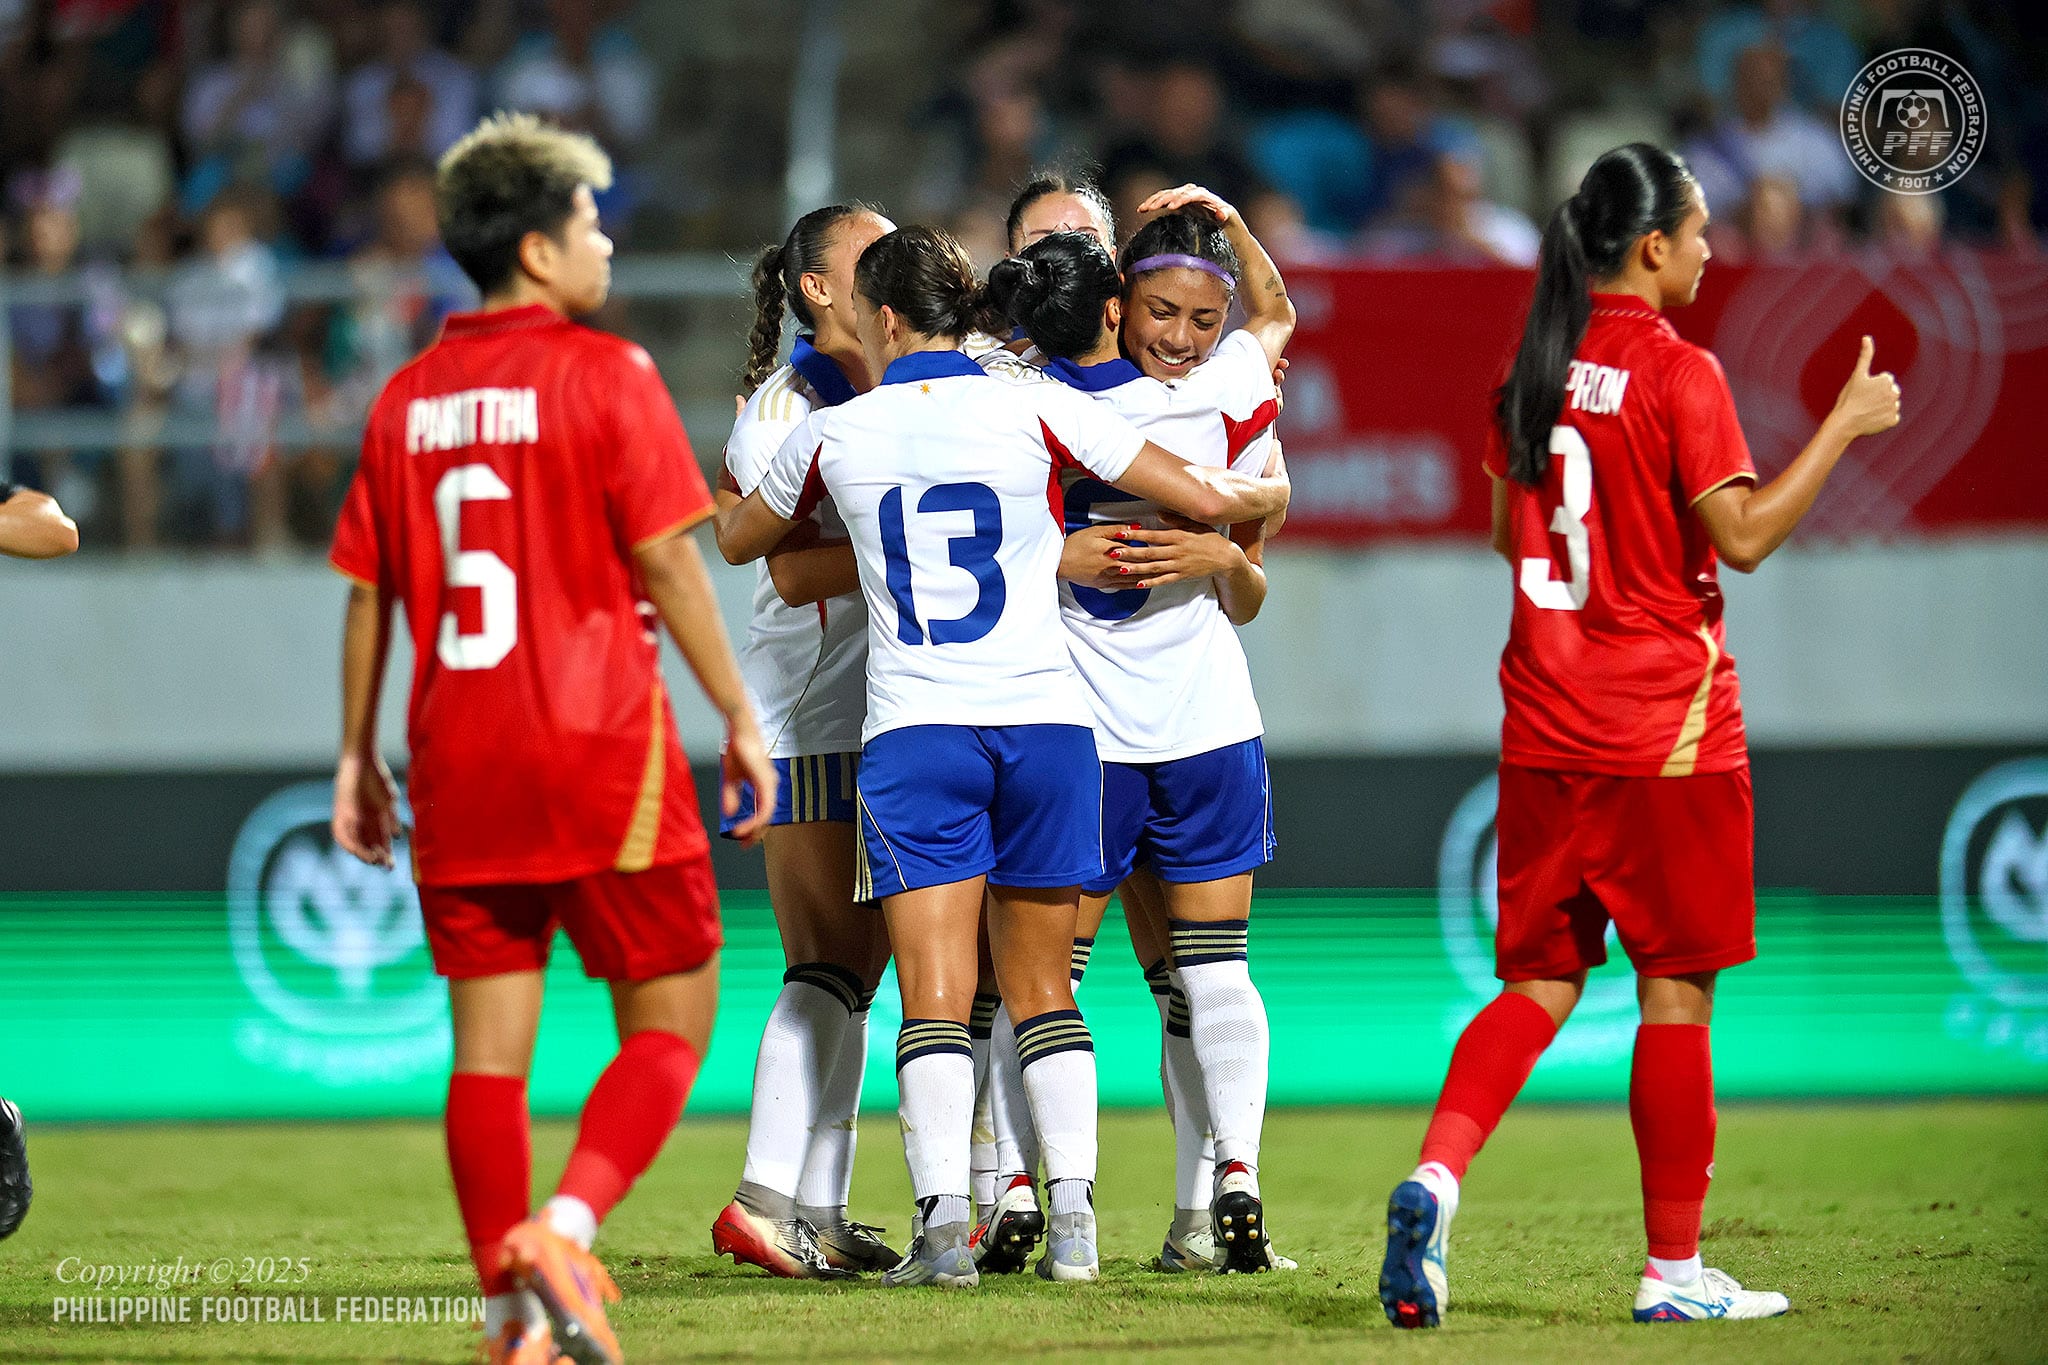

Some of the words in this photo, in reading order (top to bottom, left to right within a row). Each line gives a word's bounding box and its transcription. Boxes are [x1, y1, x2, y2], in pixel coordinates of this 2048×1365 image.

[434, 462, 518, 671] 5
[878, 481, 1006, 646] 13
[1520, 425, 1592, 610] 3
